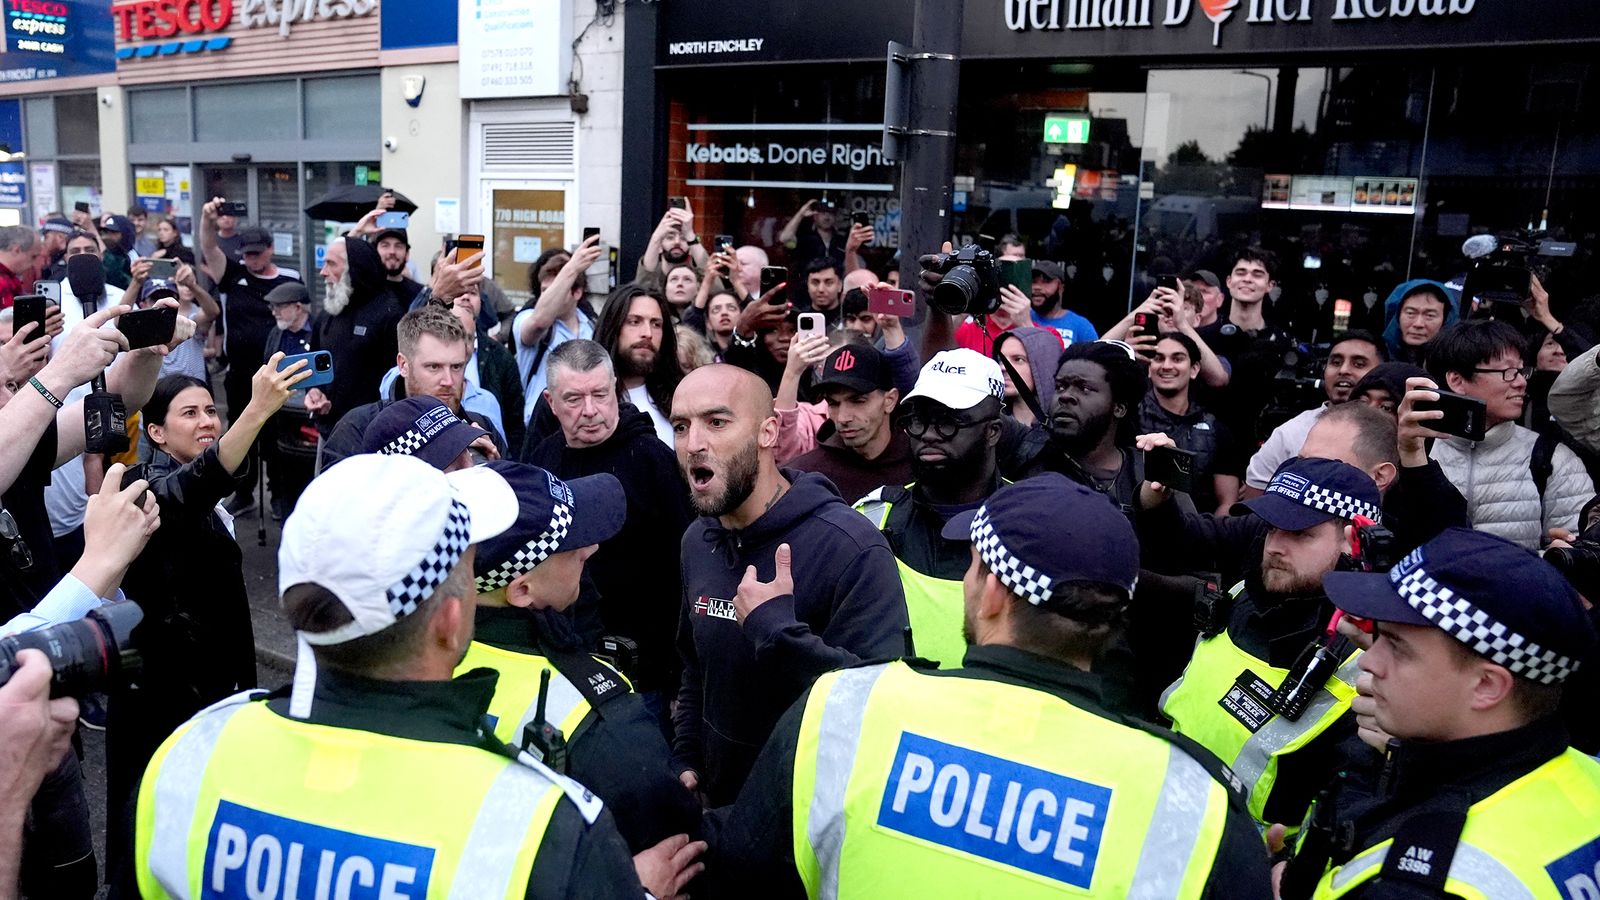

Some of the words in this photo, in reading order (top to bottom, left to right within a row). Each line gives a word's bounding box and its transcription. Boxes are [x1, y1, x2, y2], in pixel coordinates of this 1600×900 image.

[9, 0, 68, 16] TESCO
[12, 18, 66, 35] express
[111, 0, 233, 39] TESCO
[669, 42, 707, 55] NORTH
[708, 38, 764, 53] FINCHLEY
[686, 143, 764, 164] Kebabs.
[768, 144, 827, 164] Done
[513, 209, 537, 222] HIGH
[425, 422, 444, 438] POLICE
[1277, 486, 1301, 500] OFFICER
[1222, 697, 1239, 712] POLICE
[1236, 709, 1259, 729] OFFICER
[1241, 701, 1261, 718] POLICE
[891, 751, 1099, 868] POLICE
